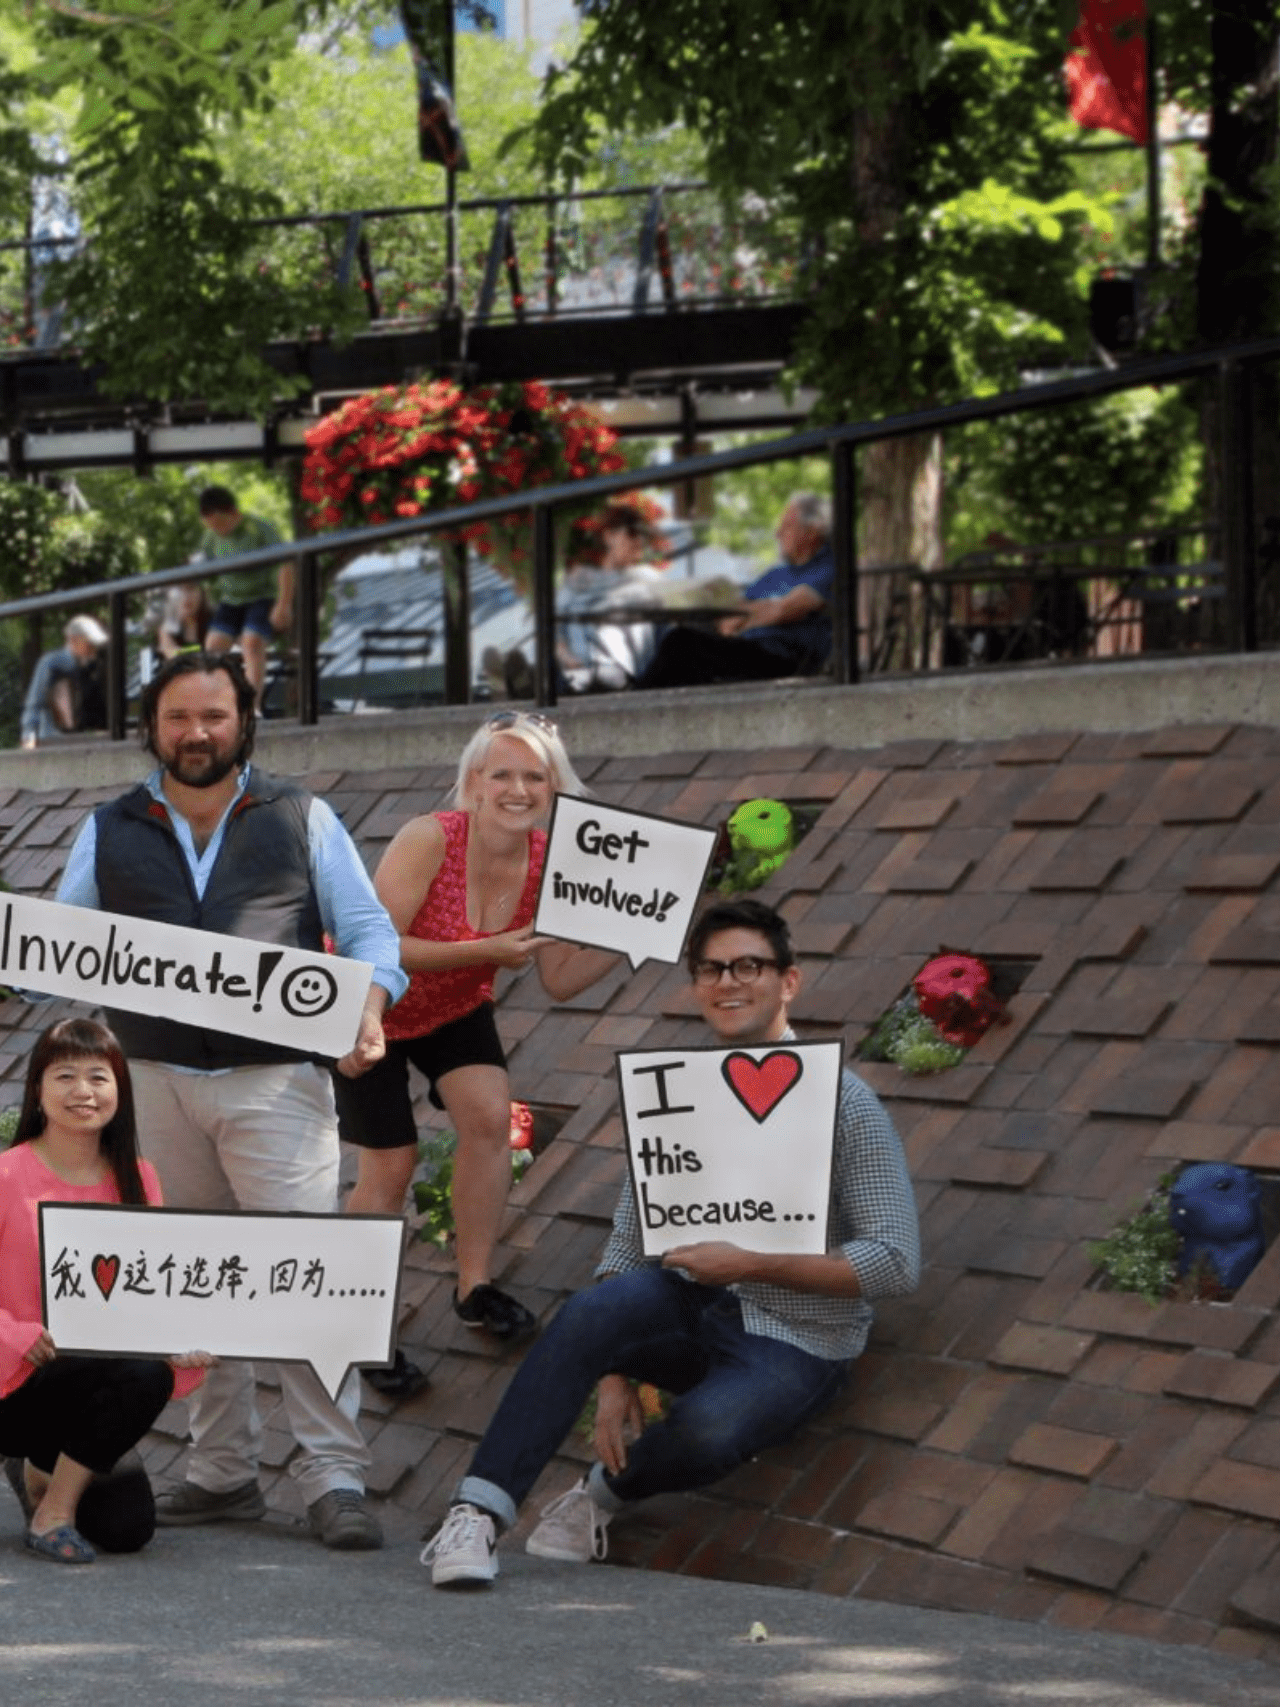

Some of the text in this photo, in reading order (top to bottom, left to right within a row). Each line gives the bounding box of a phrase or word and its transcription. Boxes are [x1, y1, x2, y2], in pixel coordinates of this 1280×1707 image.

[575, 819, 650, 864] Get
[553, 871, 680, 923] involved!
[0, 903, 285, 1013] Involúcrate!
[632, 1061, 695, 1119] I
[637, 1136, 703, 1177] this
[640, 1181, 816, 1230] because...
